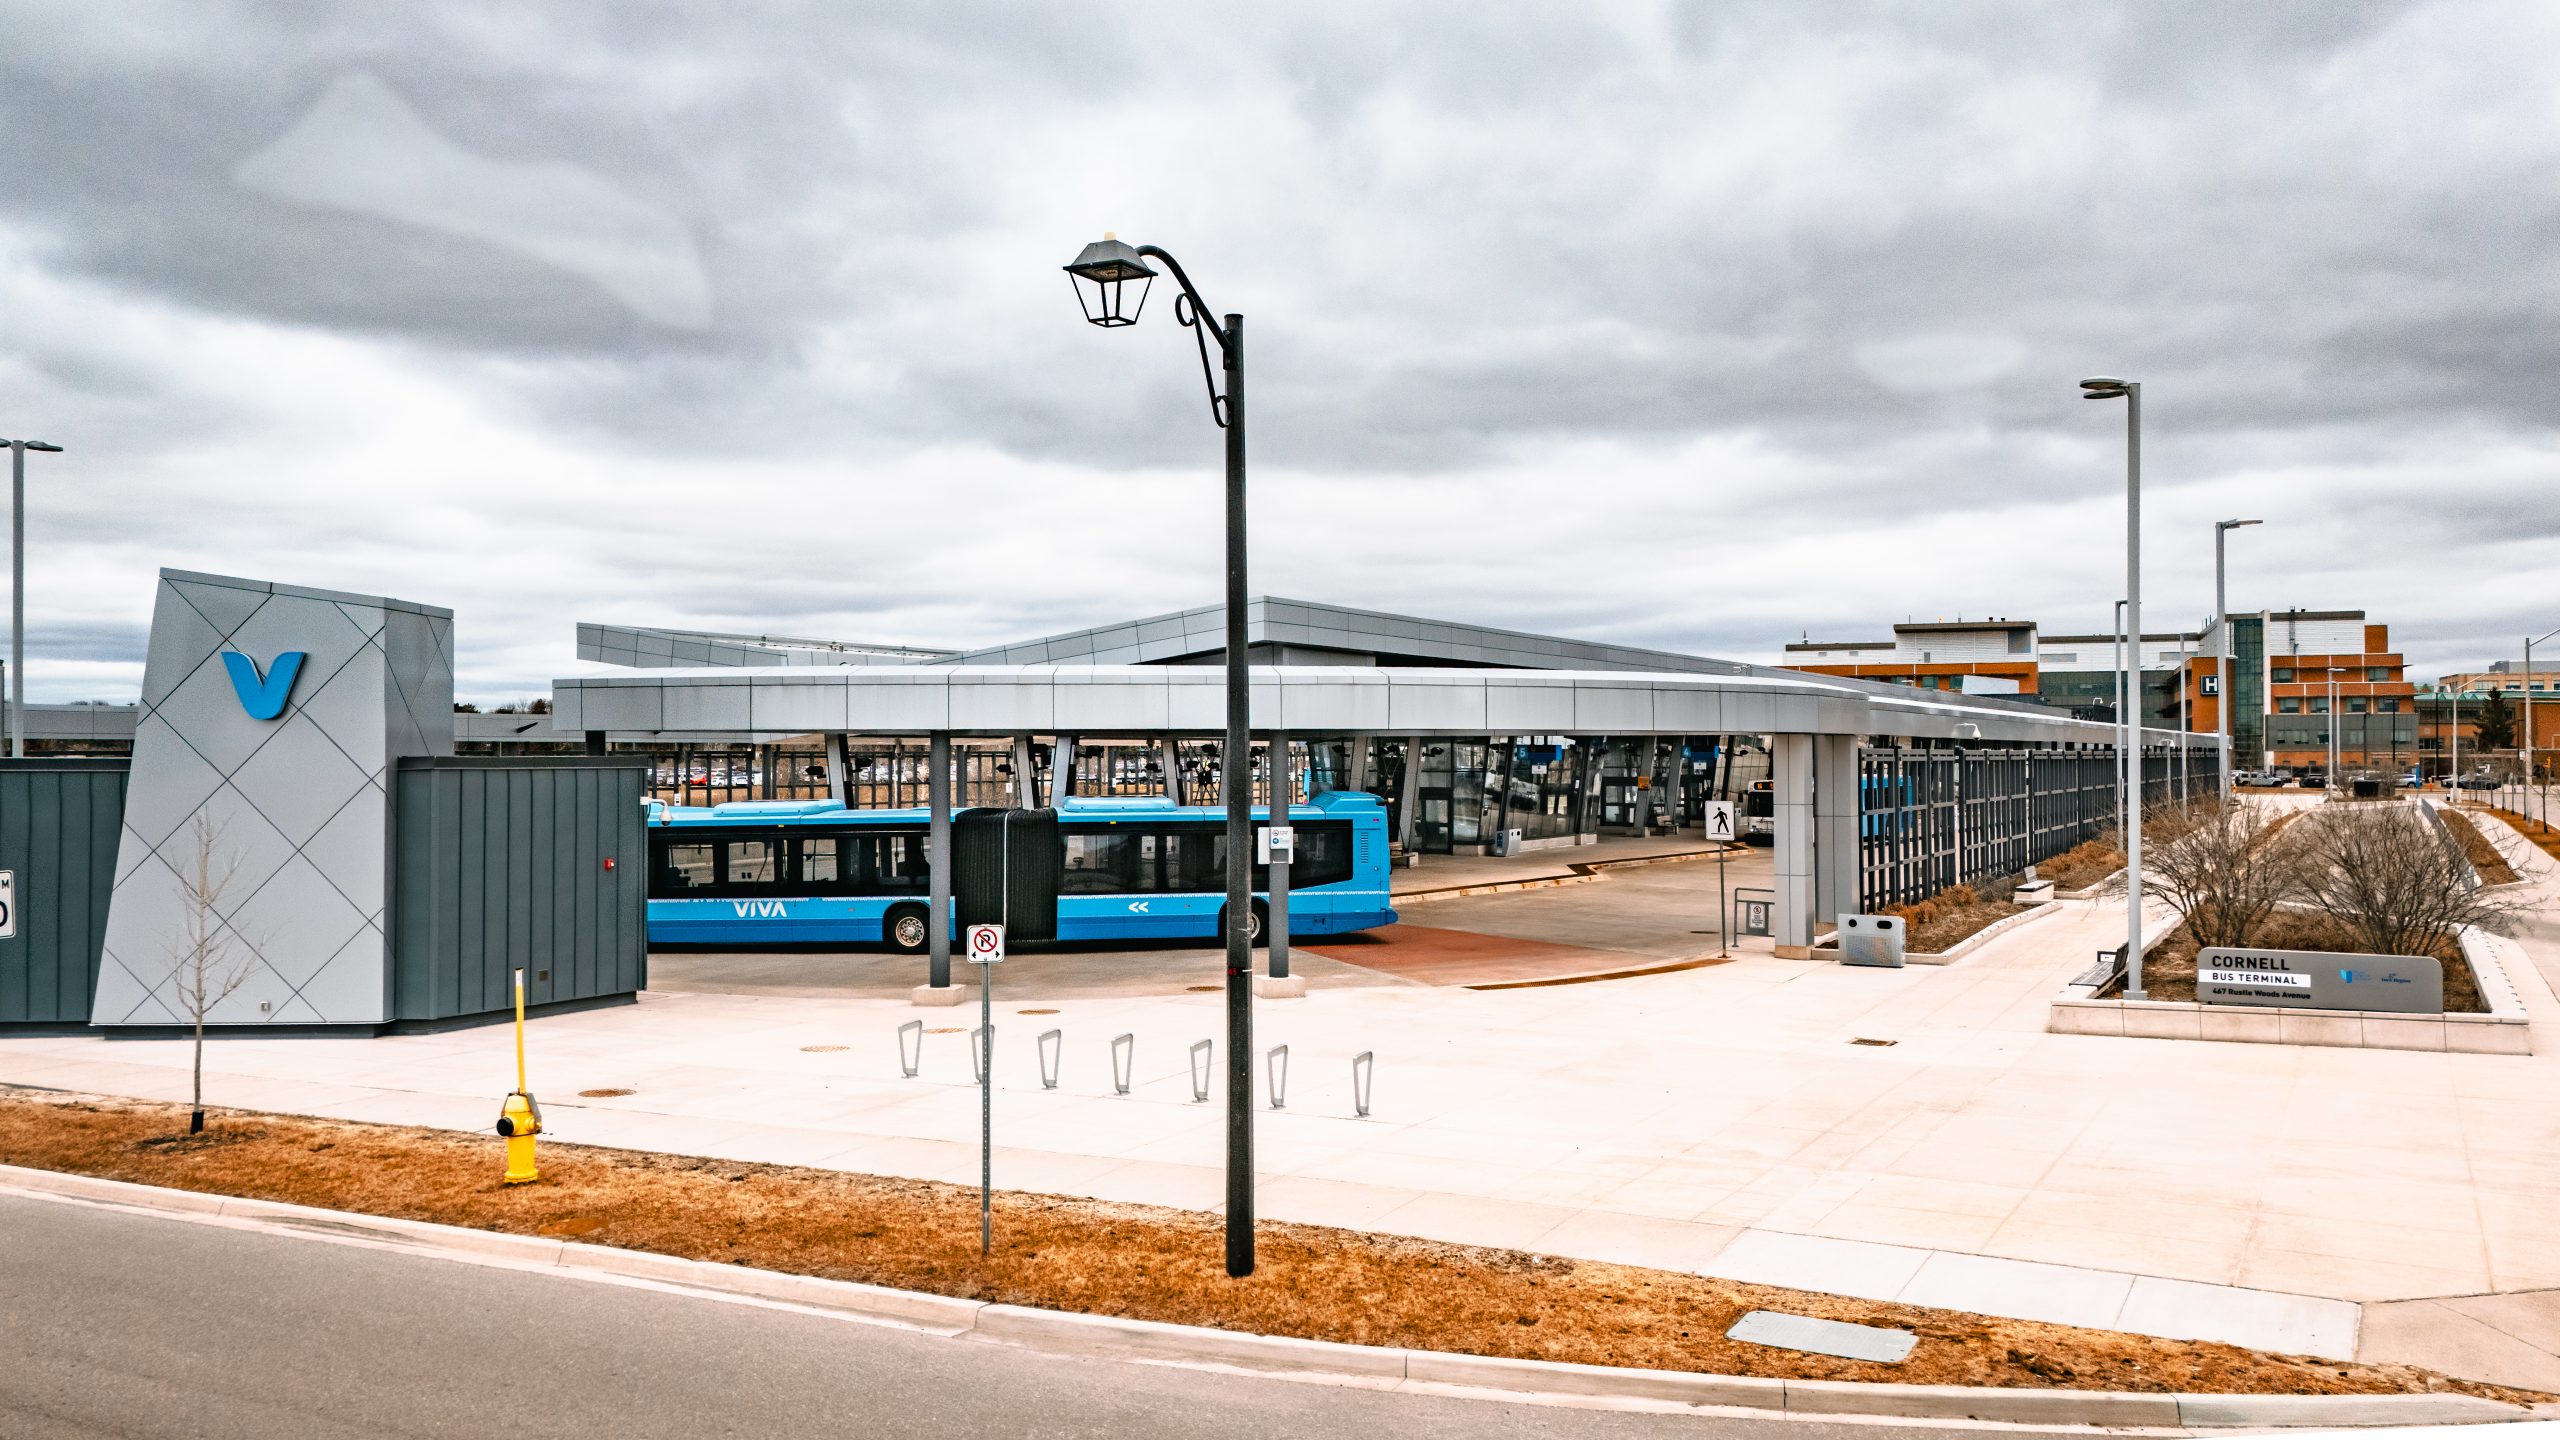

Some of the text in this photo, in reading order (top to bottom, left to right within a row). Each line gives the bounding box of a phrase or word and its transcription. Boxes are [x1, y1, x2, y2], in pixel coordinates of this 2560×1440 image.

[2205, 677, 2218, 692] H
[1519, 747, 1526, 758] 5
[733, 901, 788, 918] VIVA
[981, 934, 990, 947] P
[2212, 955, 2290, 971] CORNELL
[2212, 972, 2298, 985] BUS TERMINAL
[2212, 987, 2226, 995] 467
[2254, 989, 2280, 998] Woods
[2282, 991, 2311, 1000] Avenue
